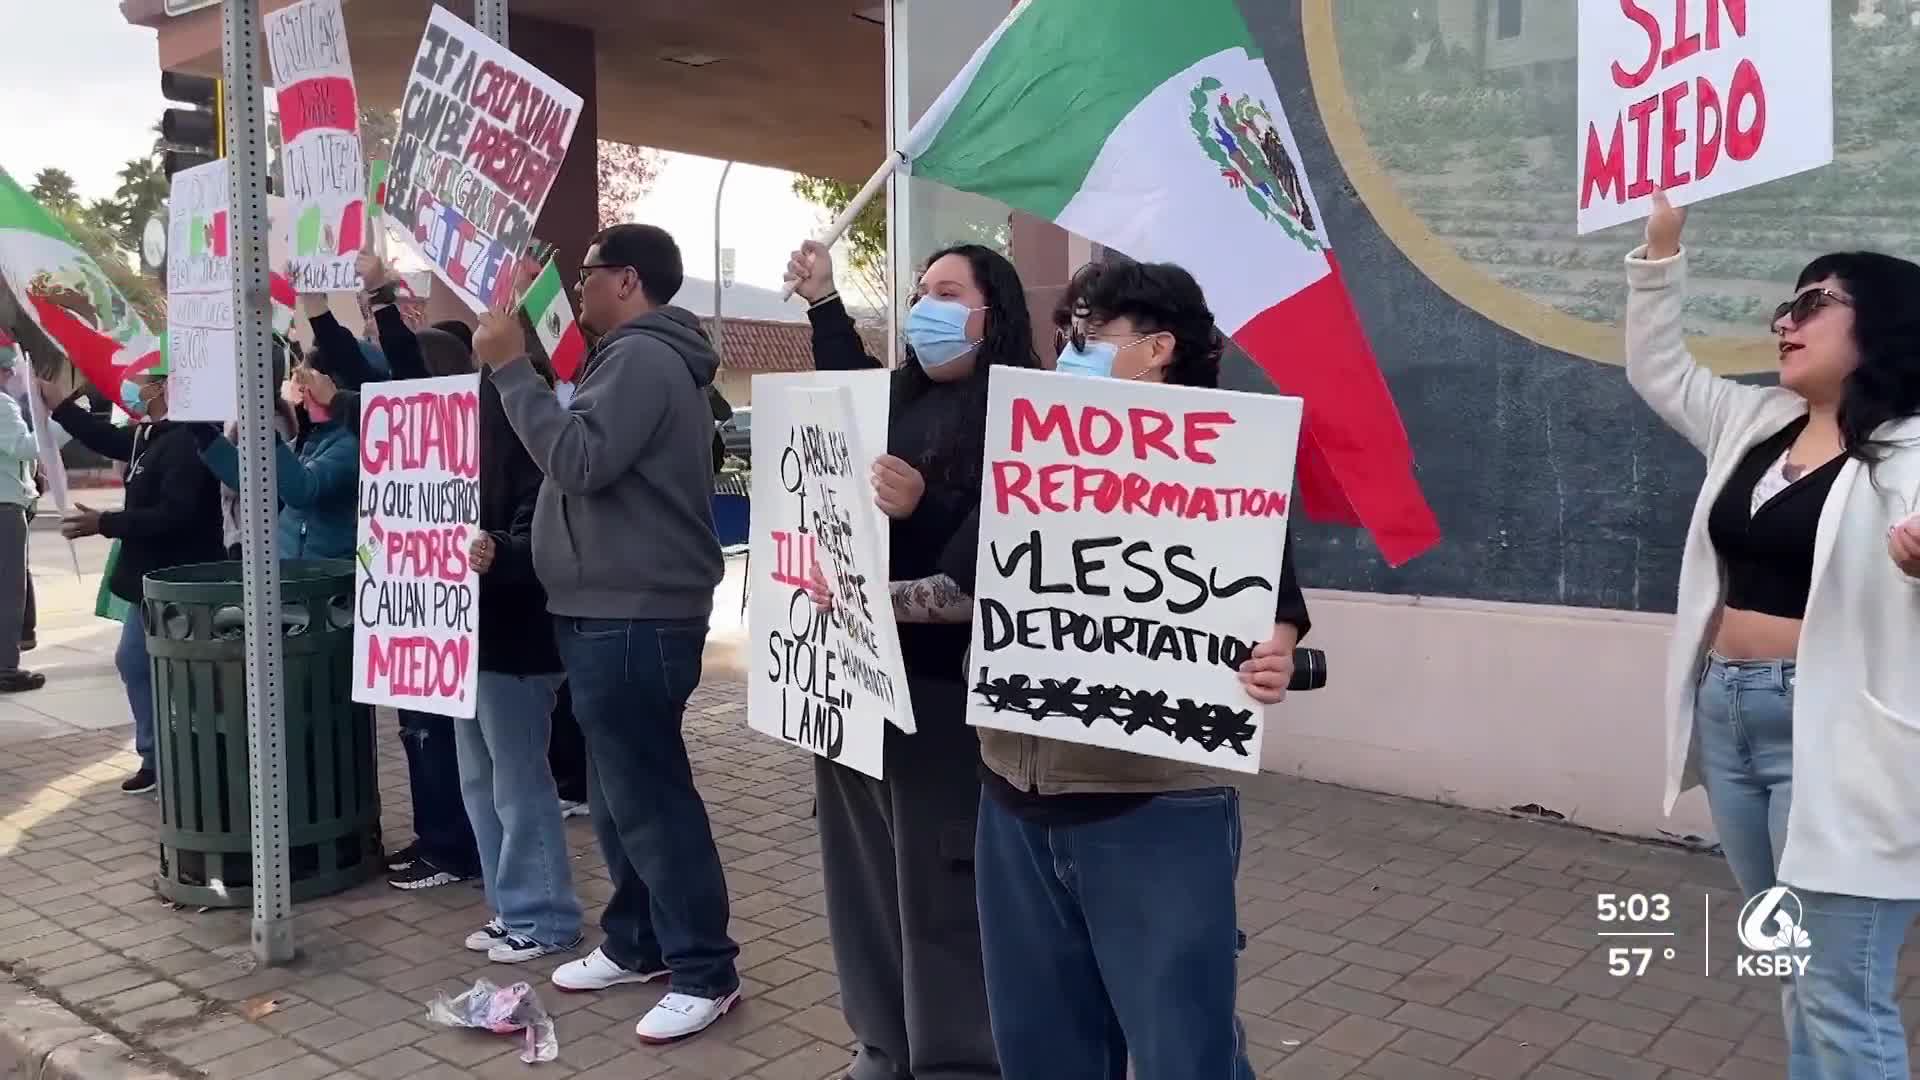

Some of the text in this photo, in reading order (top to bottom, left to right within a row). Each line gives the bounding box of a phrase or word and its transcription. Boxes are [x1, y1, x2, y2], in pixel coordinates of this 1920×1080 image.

[402, 81, 450, 142] CAN
[434, 100, 476, 158] BE
[416, 23, 464, 86] IF
[451, 50, 477, 105] A
[469, 60, 572, 164] CRIMINAL
[1580, 59, 1766, 210] MIEDO
[360, 391, 479, 478] GRITANDO
[1011, 397, 1236, 465] MORE
[360, 478, 479, 524] LO QUE NUESTROS
[992, 460, 1287, 522] REFORMATION
[386, 525, 468, 583] PADRES
[1029, 529, 1210, 614] LESS
[433, 581, 472, 632] POR
[367, 634, 470, 702] MIEDO!
[782, 687, 844, 760] LAND
